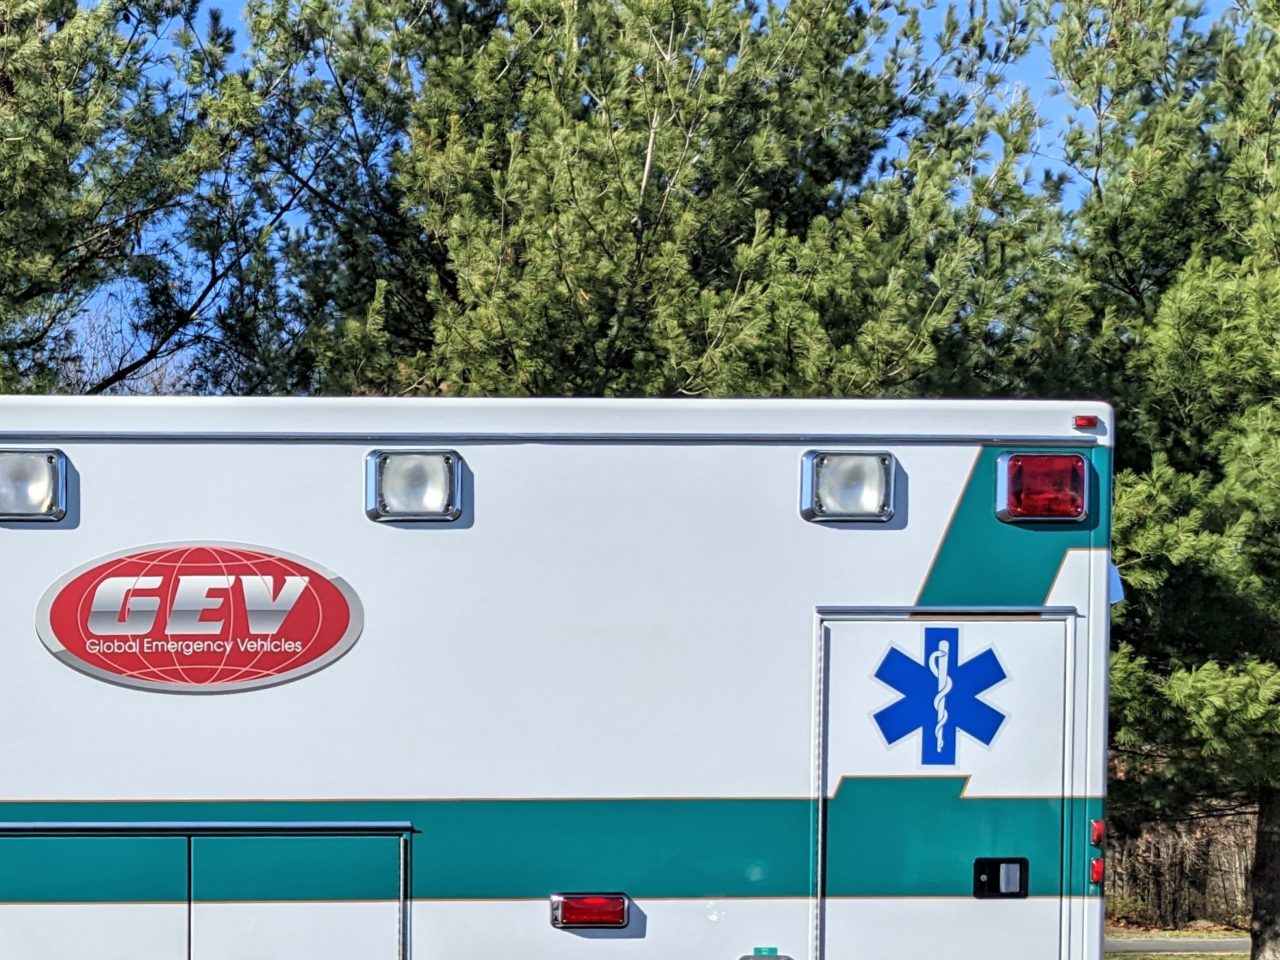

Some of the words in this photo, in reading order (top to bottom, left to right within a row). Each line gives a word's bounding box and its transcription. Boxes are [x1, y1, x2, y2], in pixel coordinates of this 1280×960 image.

[87, 575, 310, 635] GEV
[86, 638, 140, 654] Global
[143, 638, 233, 655] Emergency
[236, 637, 302, 653] Vehicles
